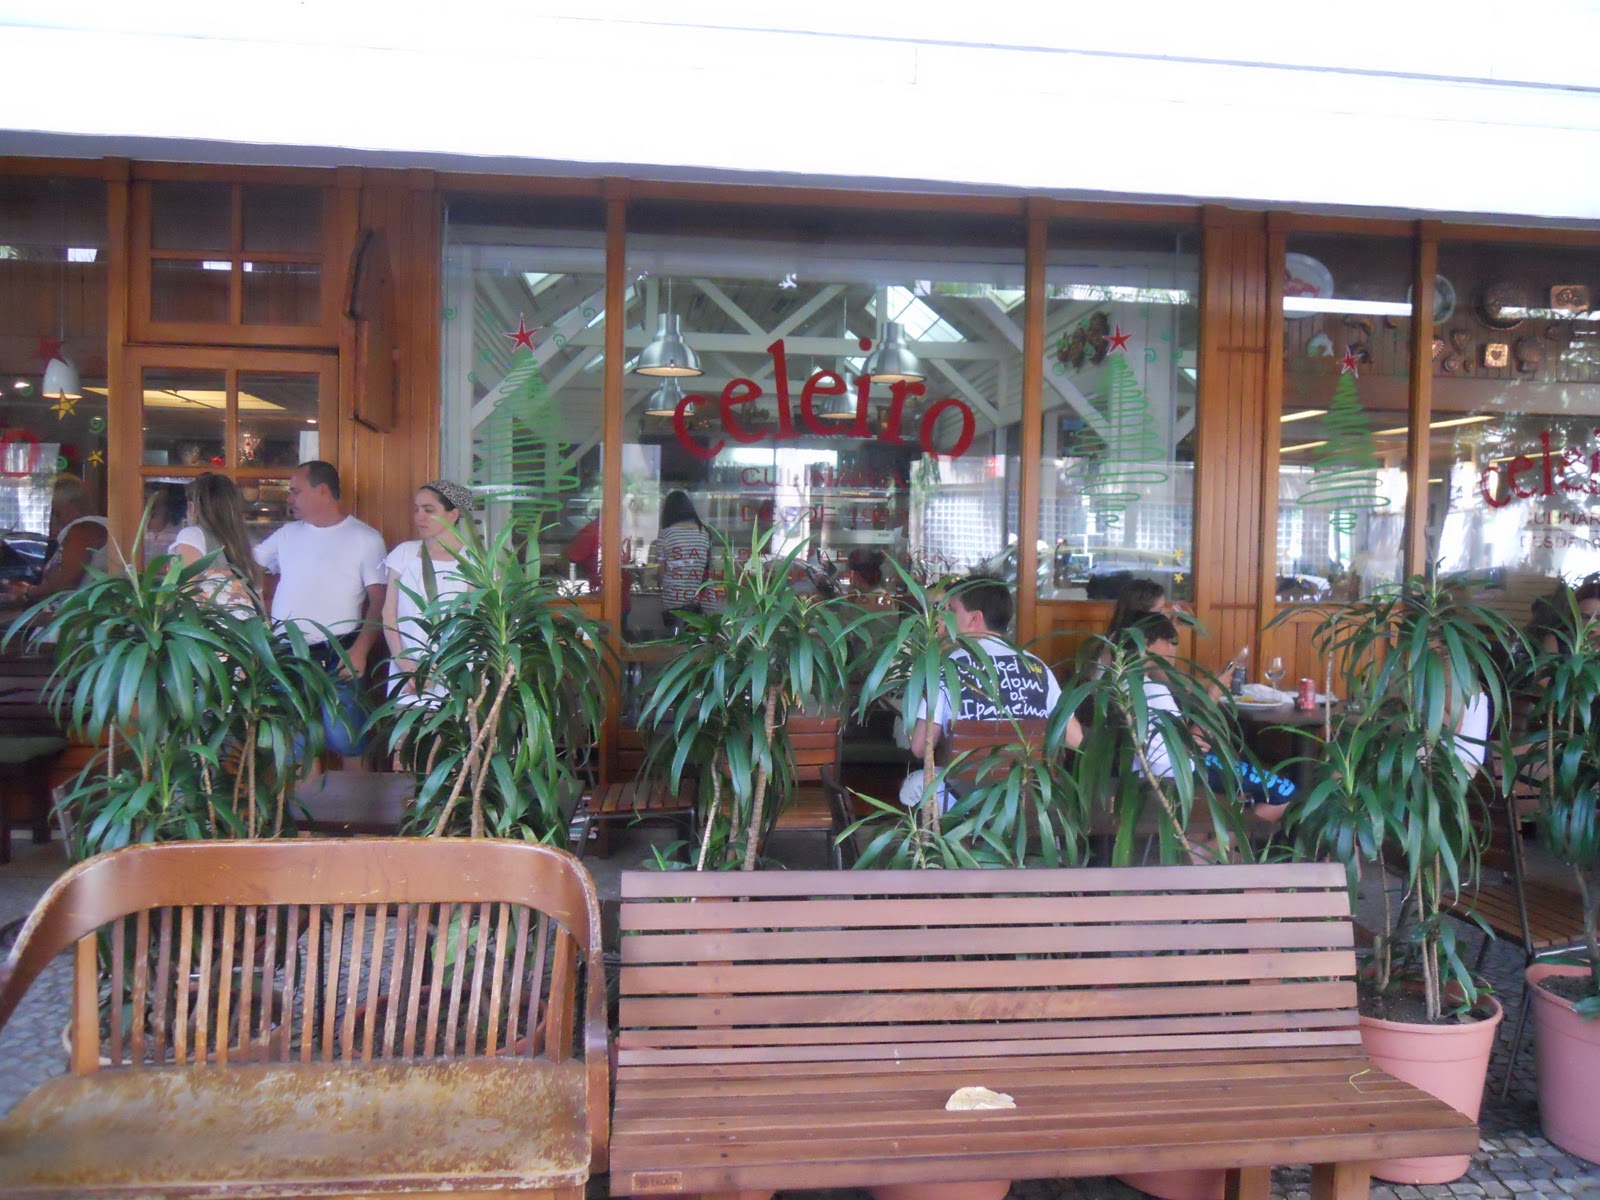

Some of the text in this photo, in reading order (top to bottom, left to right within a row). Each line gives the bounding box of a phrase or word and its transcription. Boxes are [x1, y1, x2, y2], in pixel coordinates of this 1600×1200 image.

[673, 338, 976, 460] celeiro
[1009, 687, 1028, 702] of
[957, 699, 1049, 720] Ipanema
